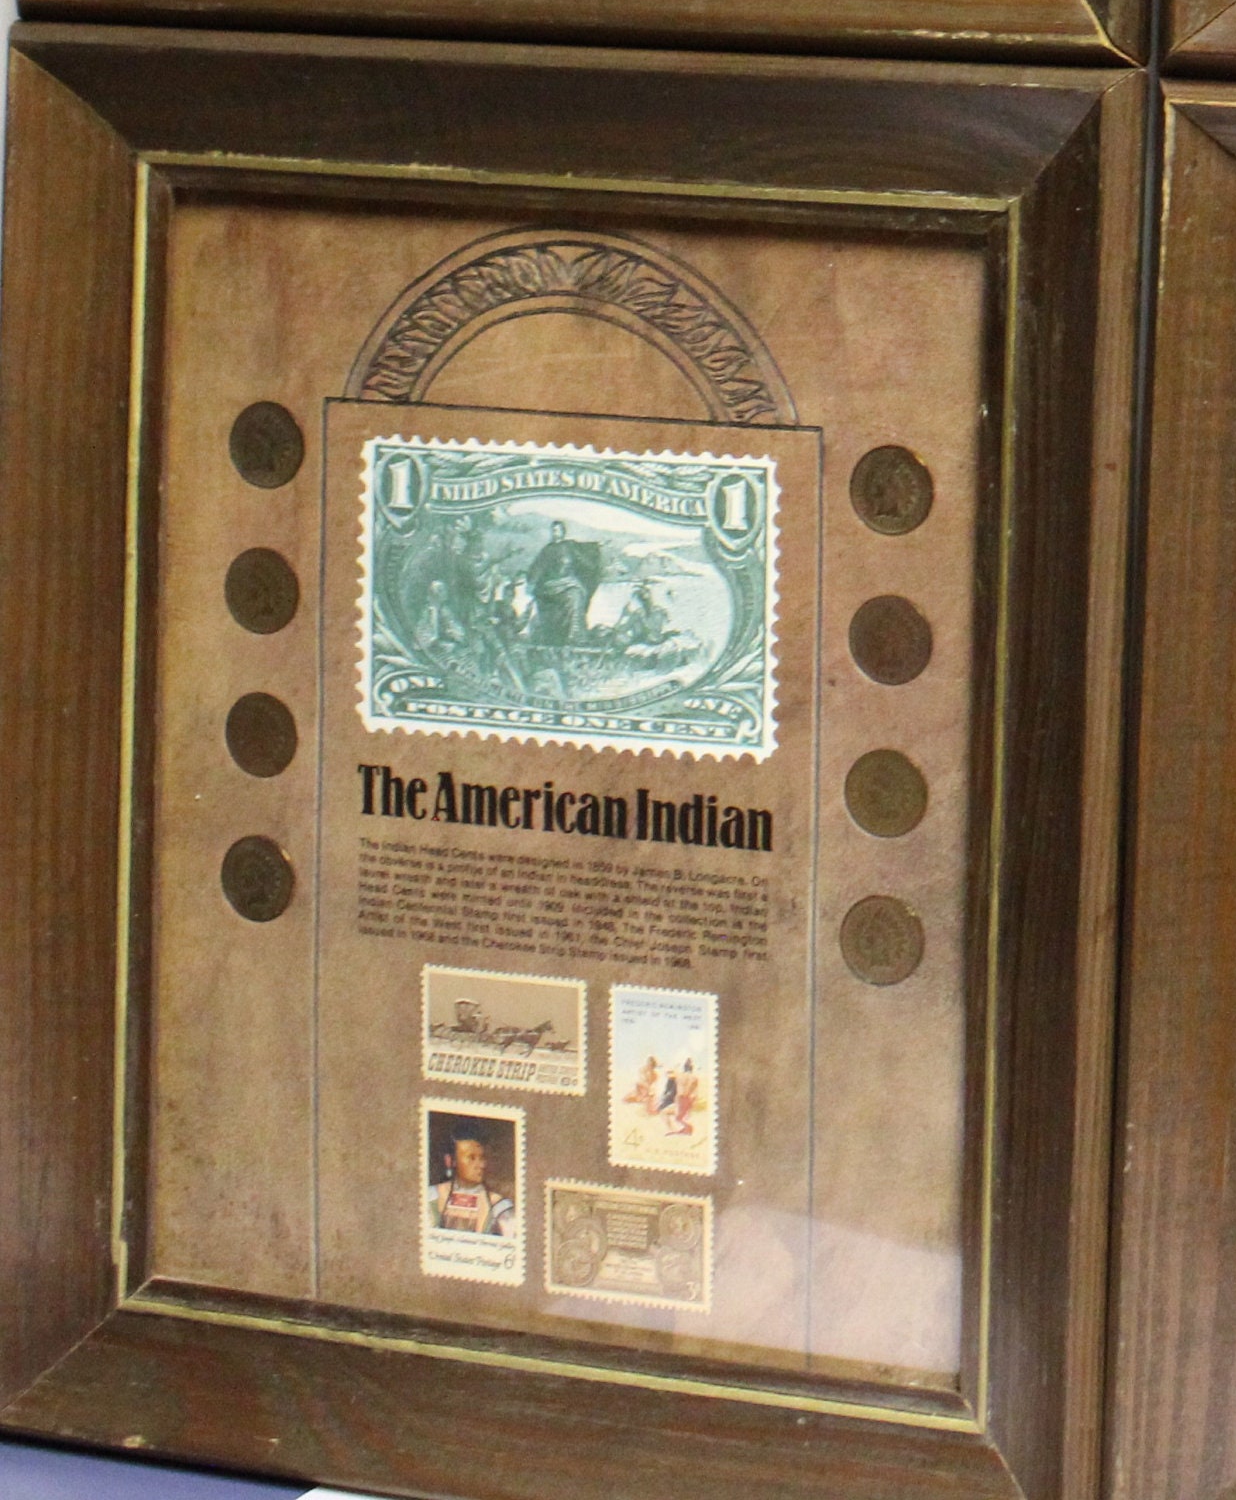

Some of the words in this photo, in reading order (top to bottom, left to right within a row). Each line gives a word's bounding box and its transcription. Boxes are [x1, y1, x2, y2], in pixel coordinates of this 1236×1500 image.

[388, 459, 413, 508] 1
[431, 479, 499, 501] UNITED
[502, 469, 574, 492] STATES
[577, 473, 605, 491] OF
[607, 479, 707, 516] AMERICA
[722, 479, 748, 530] 1
[389, 676, 445, 693] ONE
[406, 702, 555, 724] POSTAGE
[560, 715, 632, 730] ONE
[639, 721, 733, 737] CENT
[683, 698, 743, 719] ONE
[358, 764, 427, 820] The
[433, 771, 628, 840] American
[636, 788, 773, 851] Indian
[428, 1053, 497, 1078] CHEROKEE
[496, 1059, 537, 1082] STRIP
